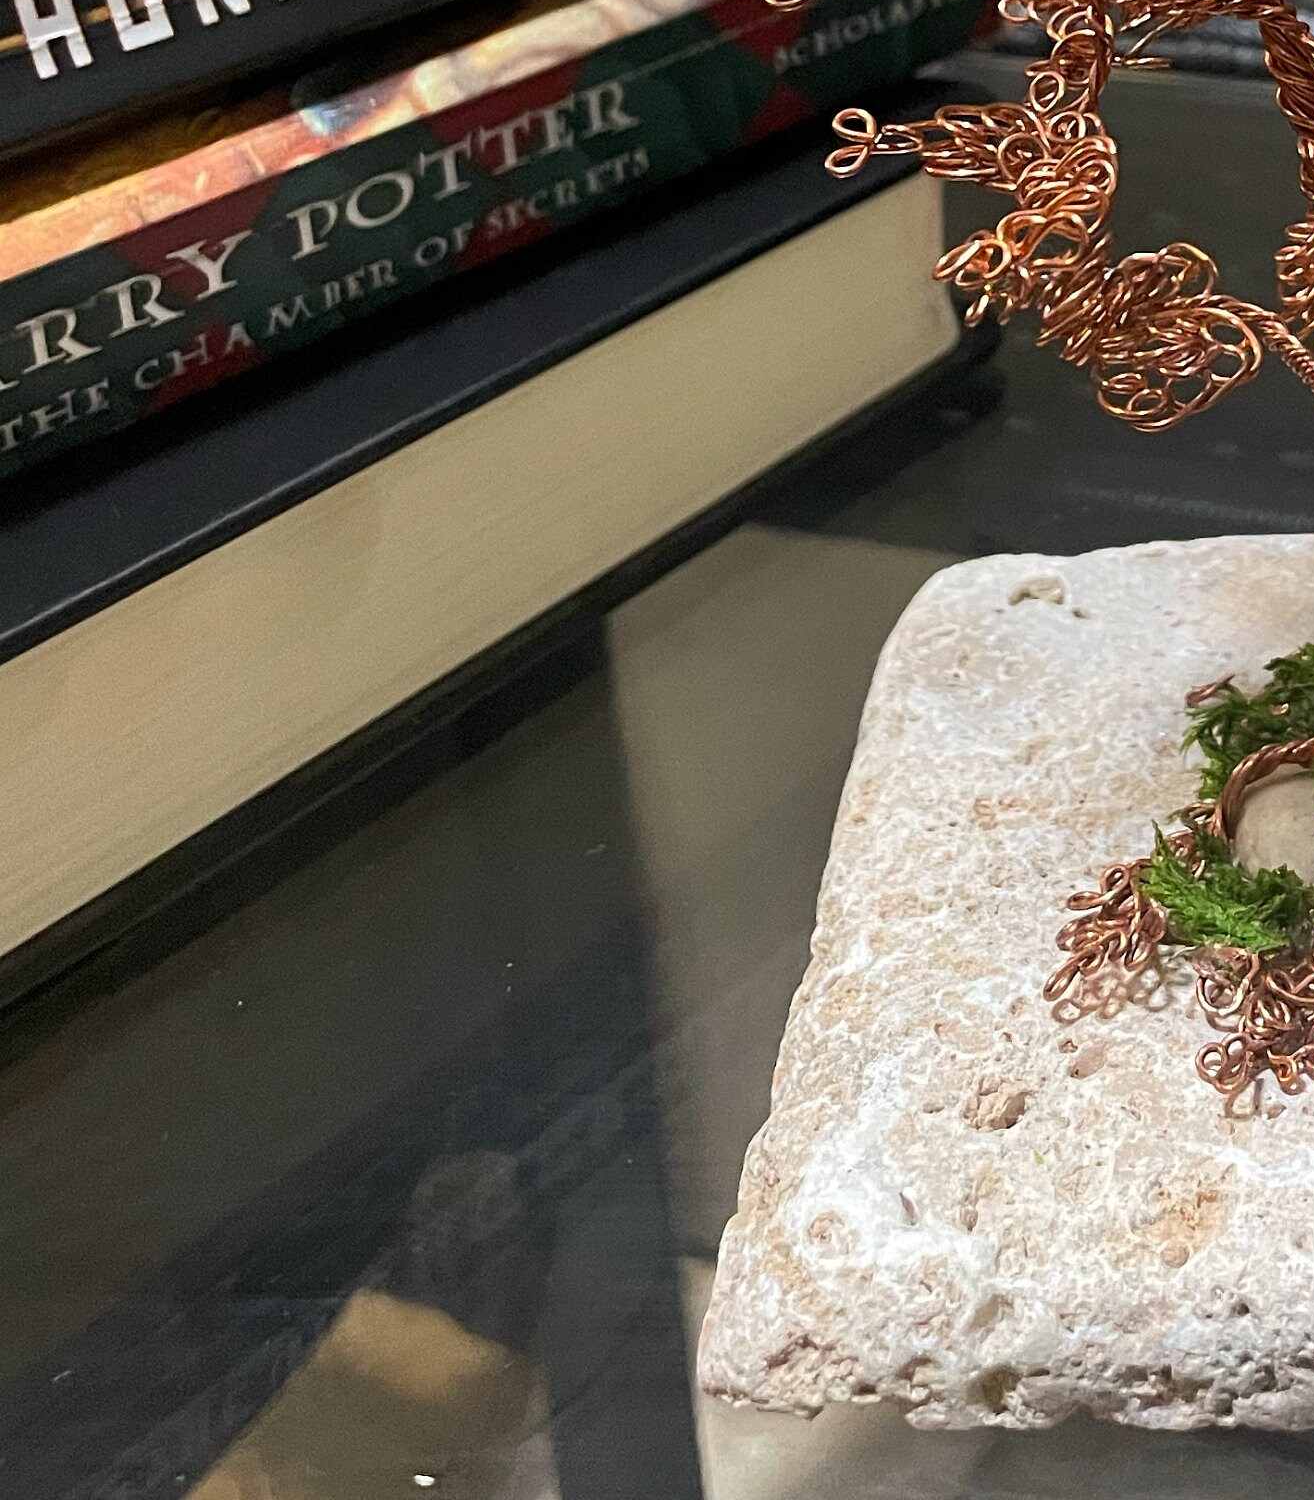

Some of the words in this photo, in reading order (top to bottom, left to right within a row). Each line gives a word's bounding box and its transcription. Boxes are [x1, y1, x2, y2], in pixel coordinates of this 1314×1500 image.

[0, 230, 253, 392] RRY
[286, 80, 640, 262] POTTER
[0, 377, 110, 451] THE
[134, 258, 398, 390] CHAMBER
[414, 221, 474, 268] OF
[486, 147, 650, 240] SECRETS
